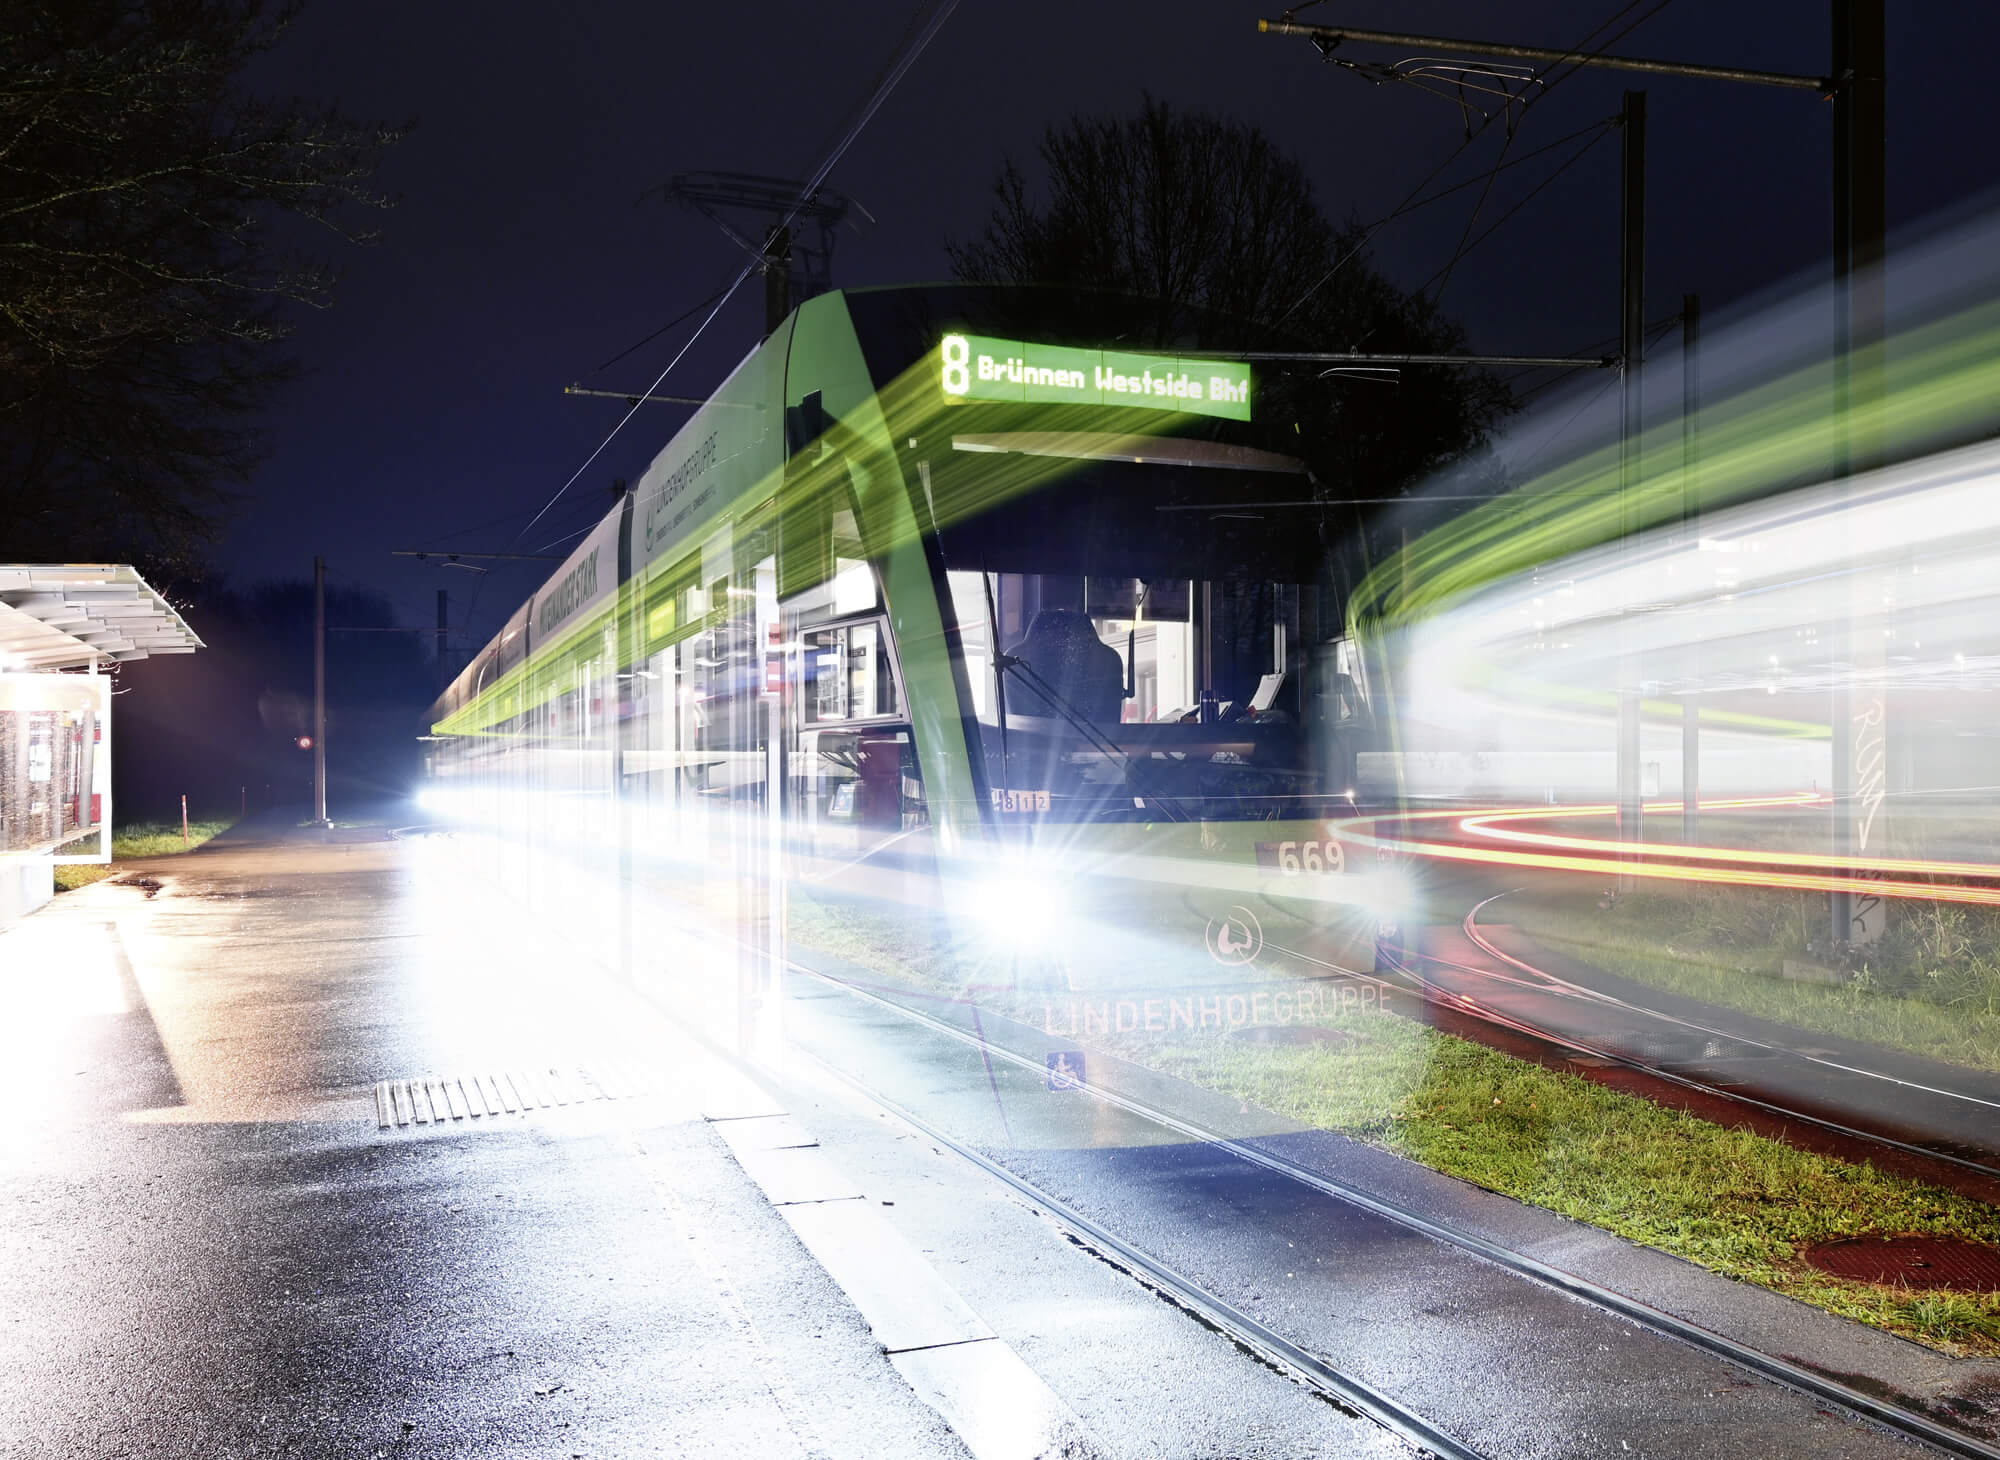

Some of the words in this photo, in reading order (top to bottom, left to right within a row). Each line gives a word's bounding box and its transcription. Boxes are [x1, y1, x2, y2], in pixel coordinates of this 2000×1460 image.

[942, 335, 969, 395] 8
[977, 355, 1085, 389] Brünnen
[1095, 366, 1202, 399] Westside
[1209, 377, 1248, 402] Bhf
[1278, 841, 1345, 877] 669
[1045, 984, 1392, 1036] LINDENHOFGRUPPE
